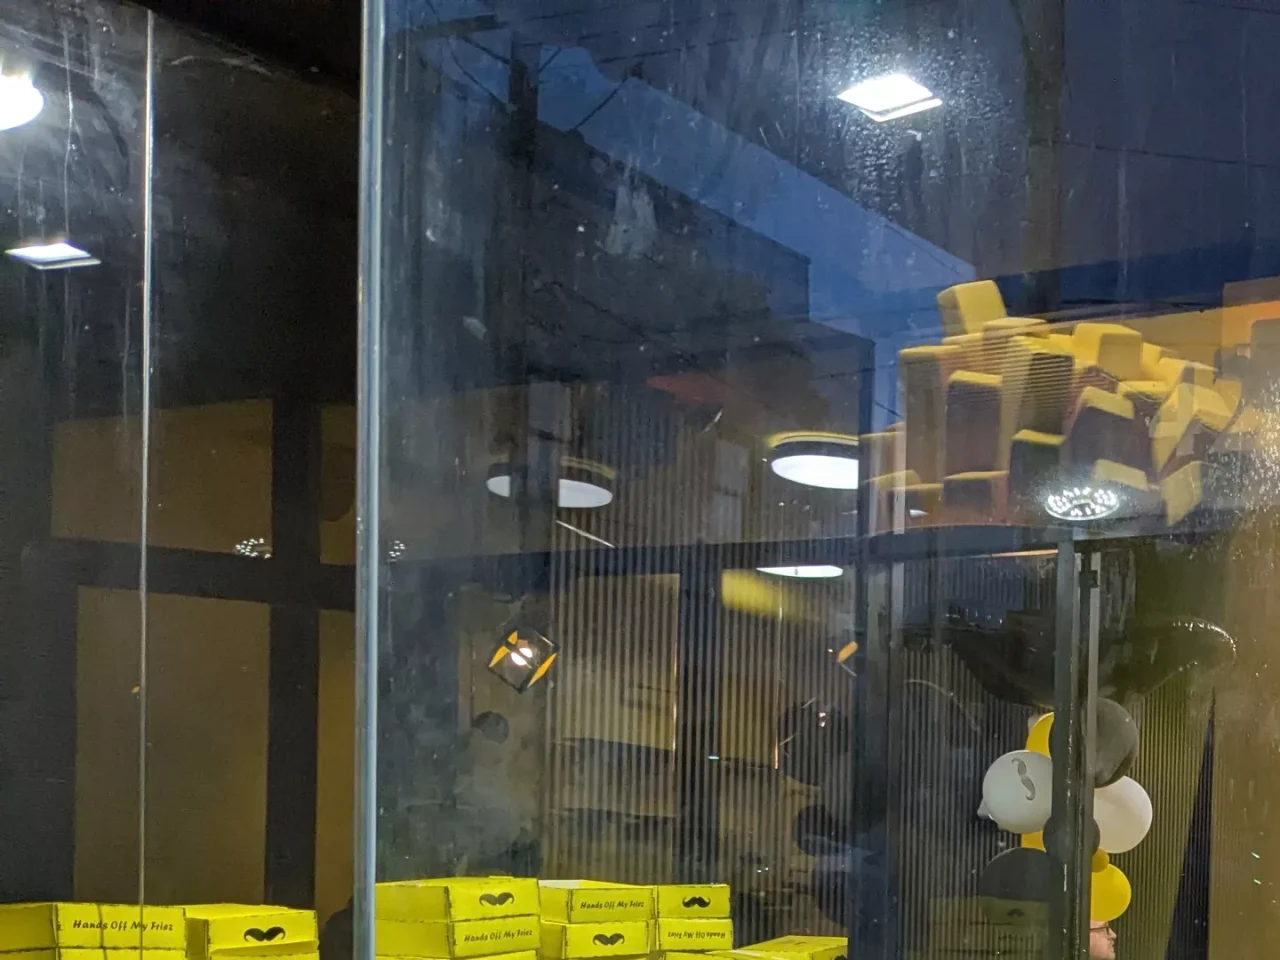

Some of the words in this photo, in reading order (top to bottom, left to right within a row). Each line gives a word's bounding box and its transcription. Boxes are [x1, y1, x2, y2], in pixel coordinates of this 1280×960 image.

[604, 901, 615, 910] Off
[616, 901, 628, 909] My
[73, 920, 108, 930] Hands
[110, 920, 127, 931] Off
[131, 922, 147, 931] My
[150, 921, 174, 931] Friez
[464, 934, 488, 942] Hands
[490, 932, 501, 941] Off
[503, 931, 515, 939] My
